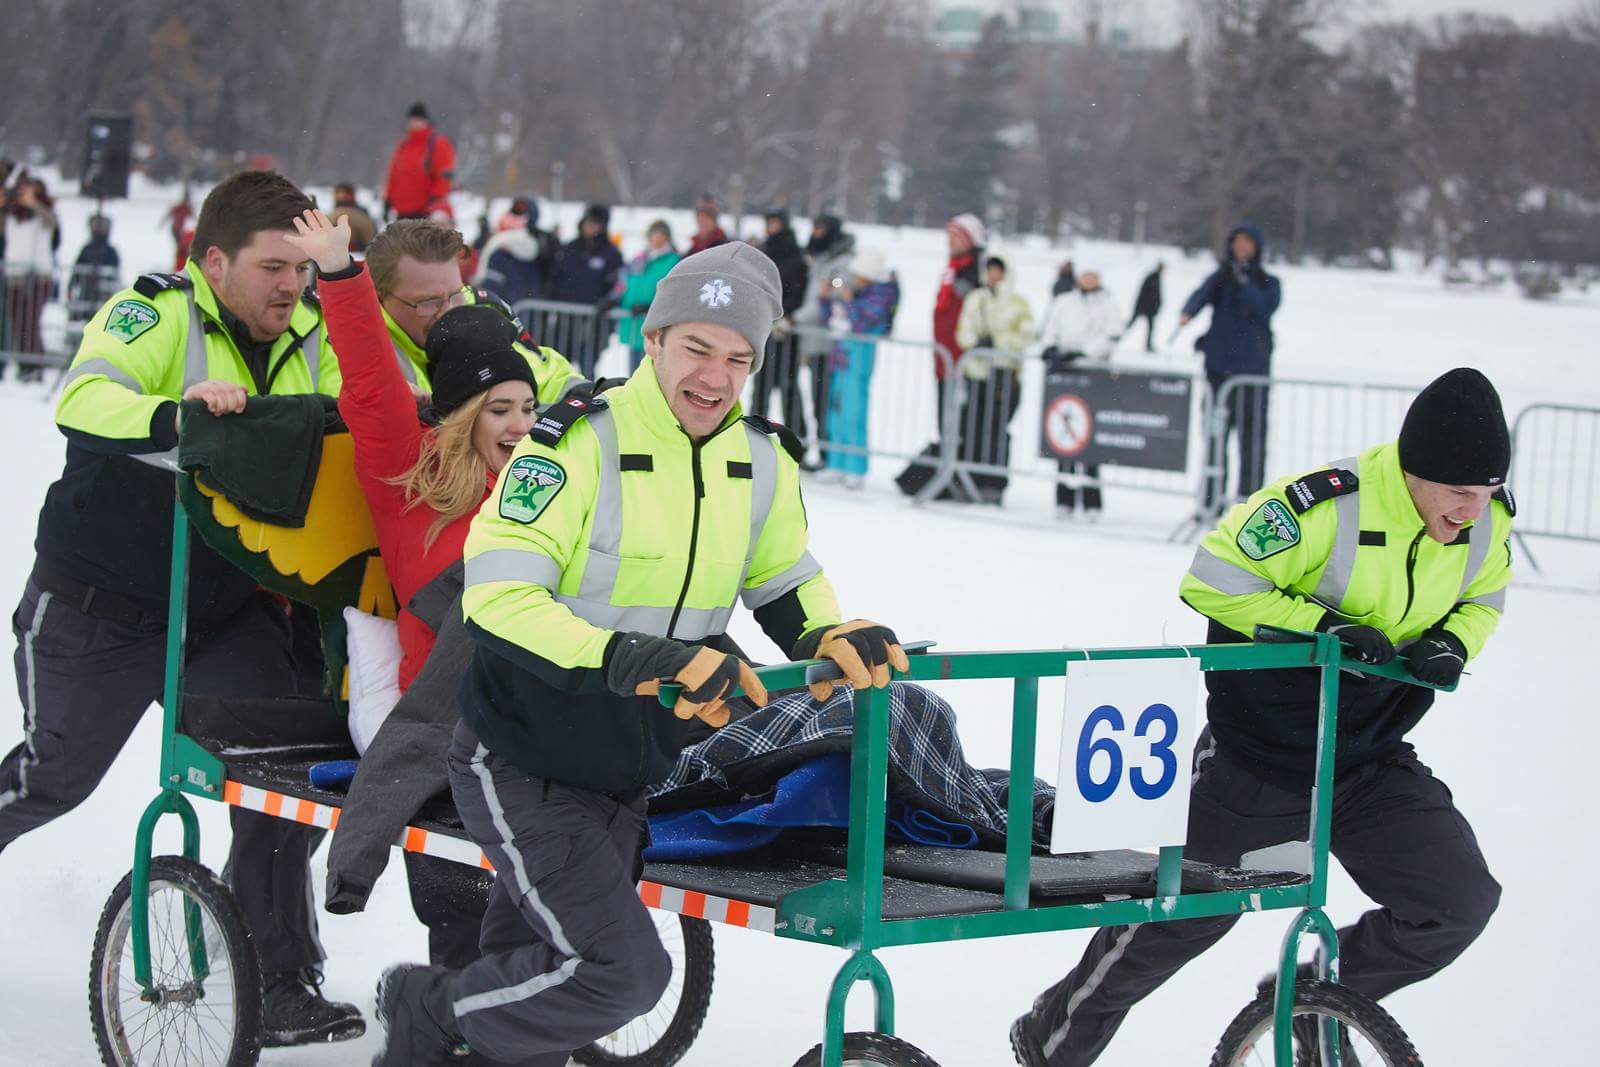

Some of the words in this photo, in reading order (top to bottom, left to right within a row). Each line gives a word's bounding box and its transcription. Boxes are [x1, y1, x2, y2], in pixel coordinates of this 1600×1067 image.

[541, 417, 564, 429] STUDENT
[518, 460, 558, 476] ALGONQUIN
[1299, 481, 1315, 502] STUDENT
[1271, 503, 1297, 535] ALGONQUIN
[1076, 703, 1179, 803] 63
